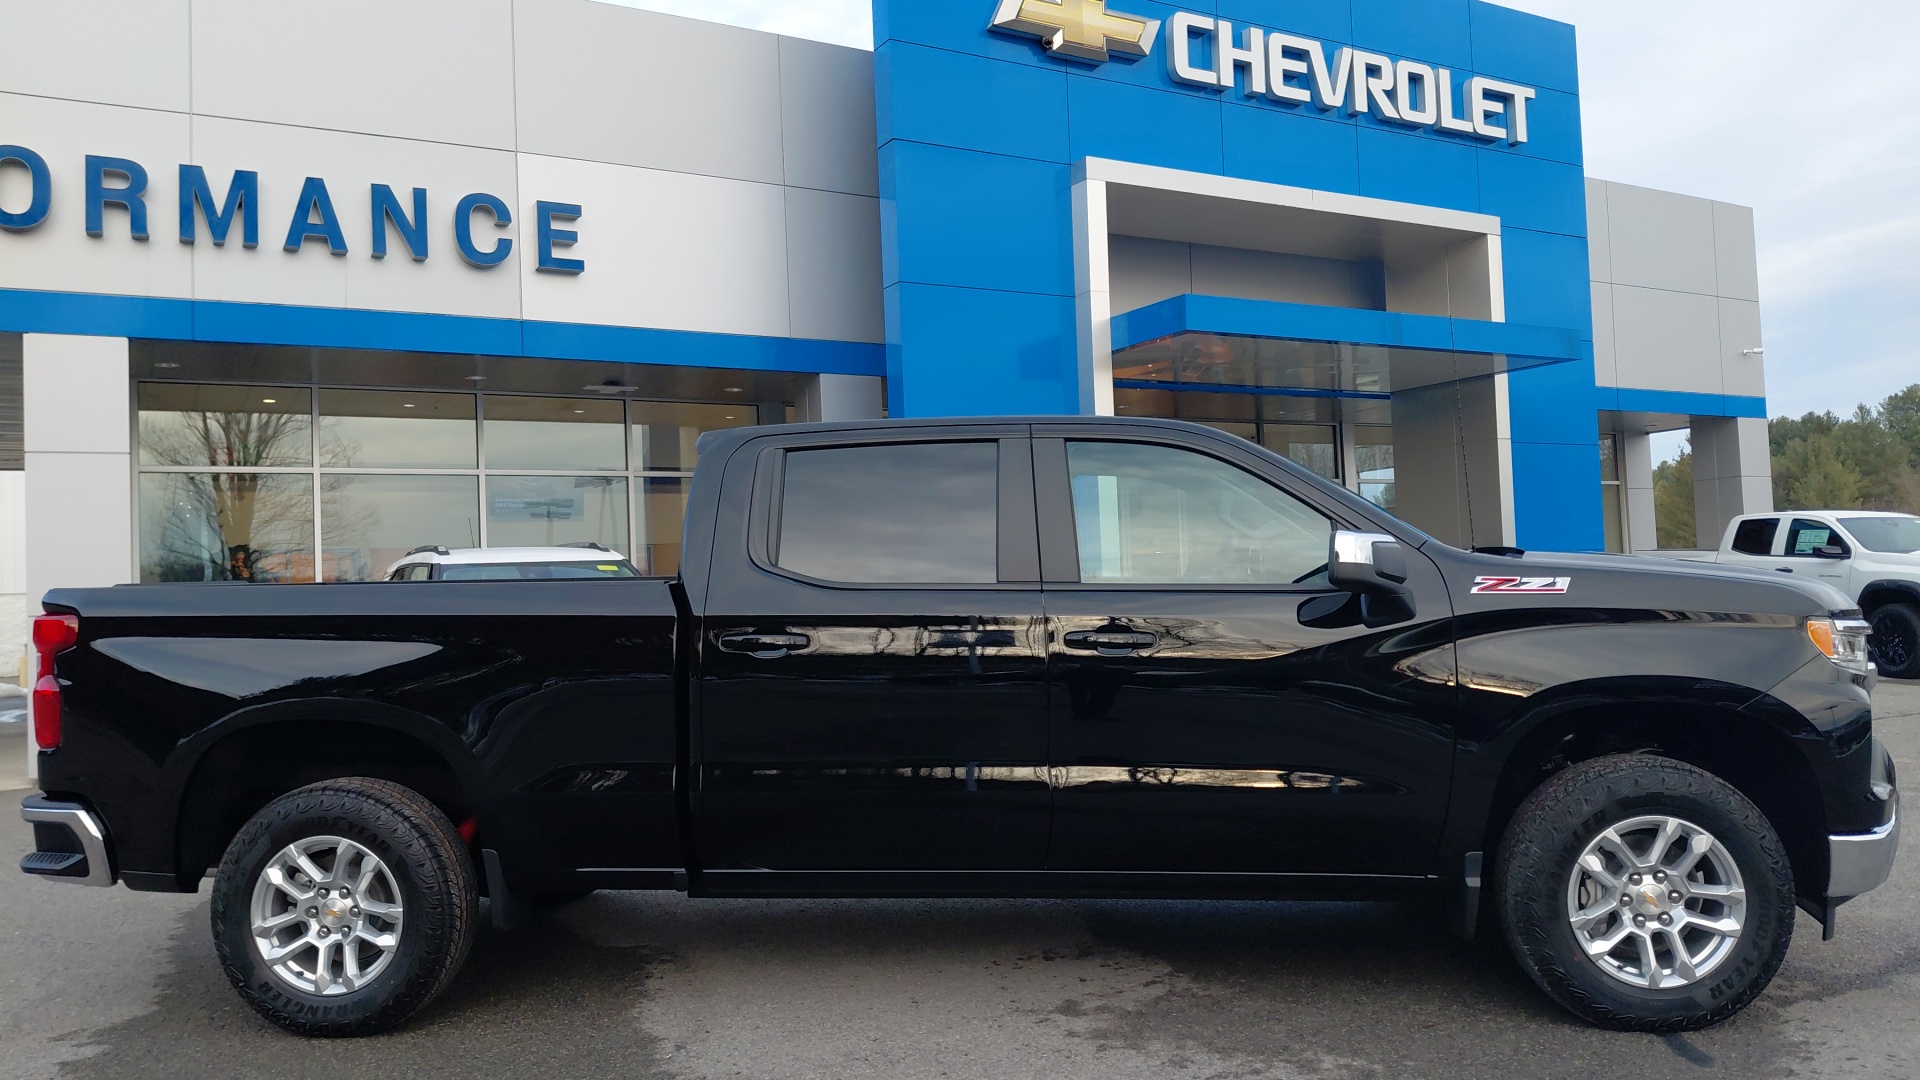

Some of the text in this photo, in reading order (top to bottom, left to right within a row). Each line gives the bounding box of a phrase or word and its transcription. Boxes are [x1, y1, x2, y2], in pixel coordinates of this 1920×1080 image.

[1166, 11, 1536, 146] CHEVROLET
[0, 144, 585, 275] ORMANCE
[1470, 576, 1572, 594] Z71
